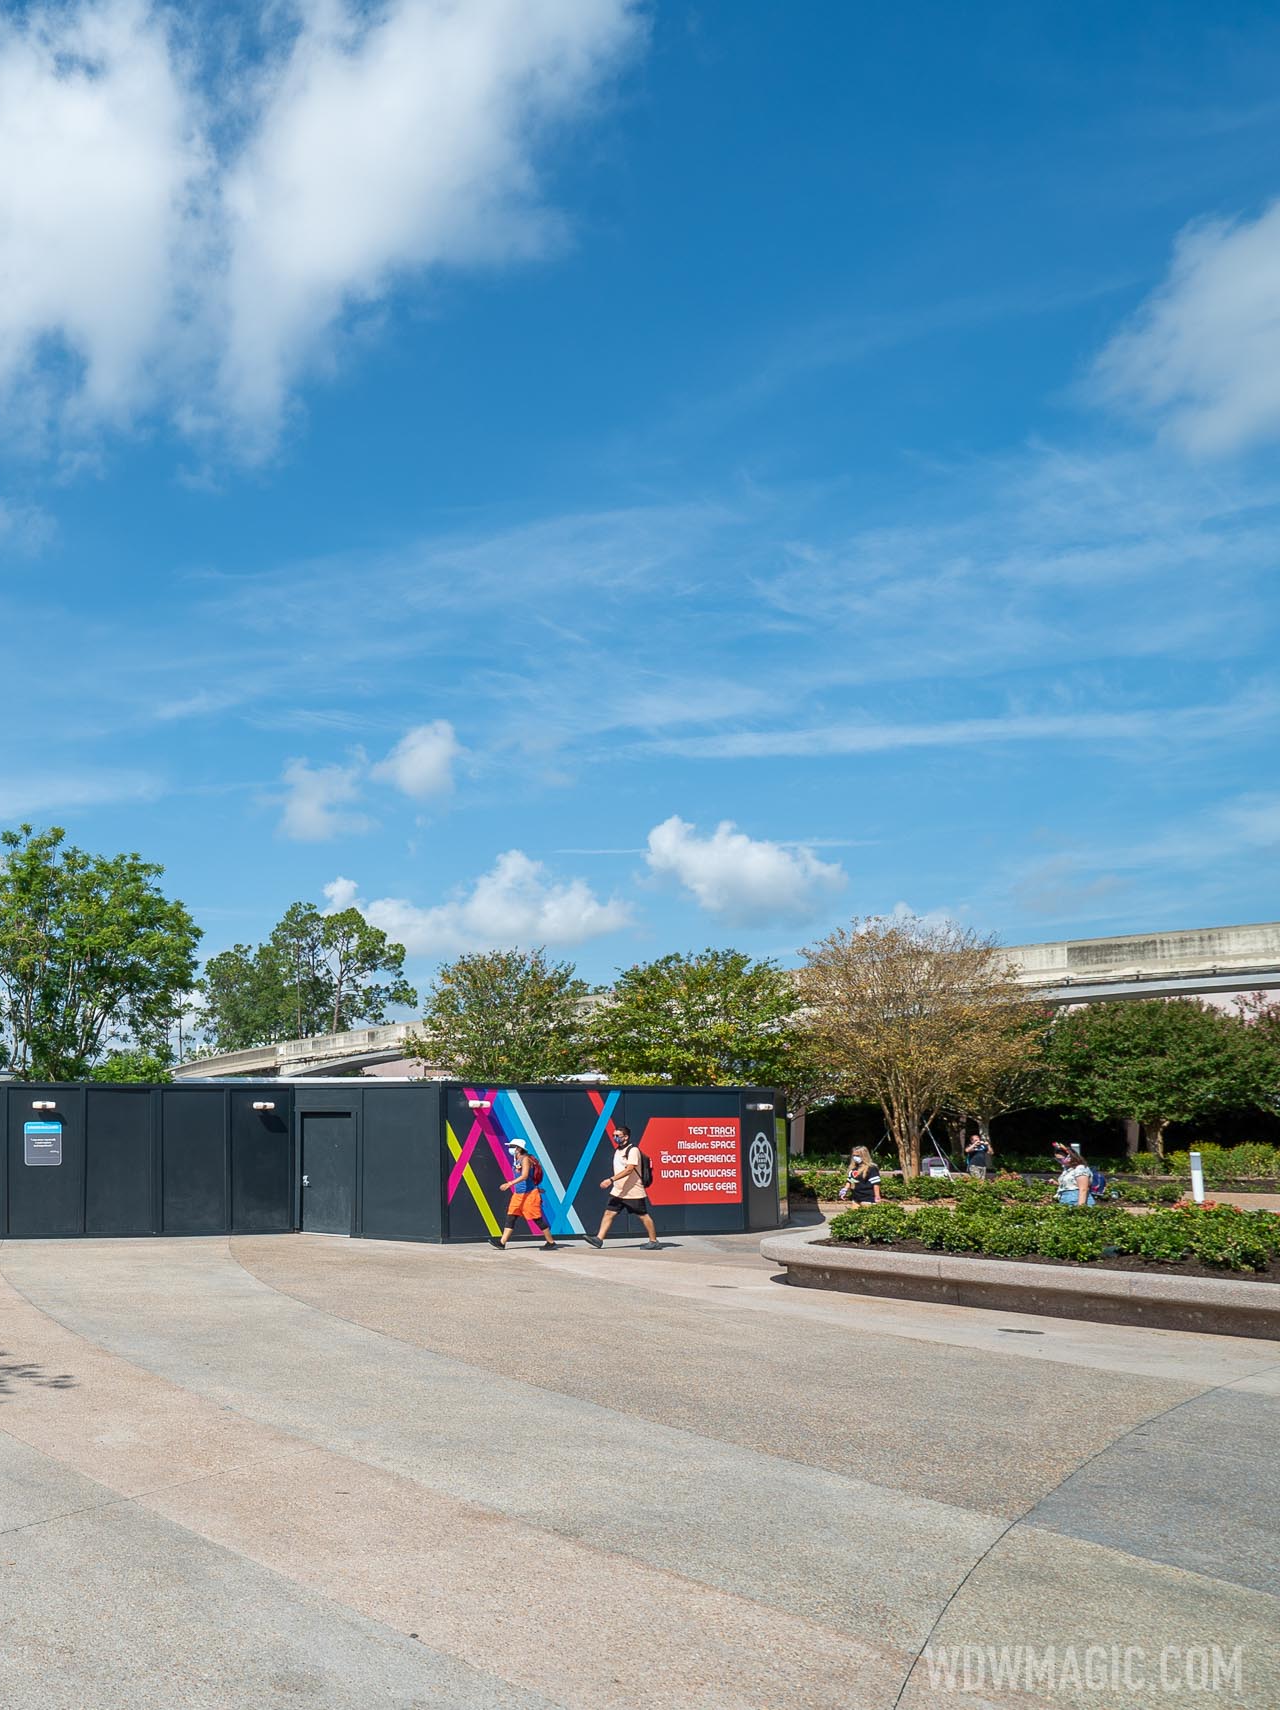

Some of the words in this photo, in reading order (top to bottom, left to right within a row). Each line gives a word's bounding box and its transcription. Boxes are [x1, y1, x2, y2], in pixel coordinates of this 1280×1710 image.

[688, 1126, 708, 1135] TEST
[709, 1126, 736, 1135] TRACK
[710, 1140, 736, 1149] SPACE
[661, 1155, 687, 1164] EPCOT
[688, 1154, 736, 1163] EXPERIENCE
[661, 1169, 690, 1178] WORLD
[691, 1169, 737, 1178] SHOWCASE
[684, 1182, 714, 1192] MOUSE
[715, 1182, 737, 1191] GEAR
